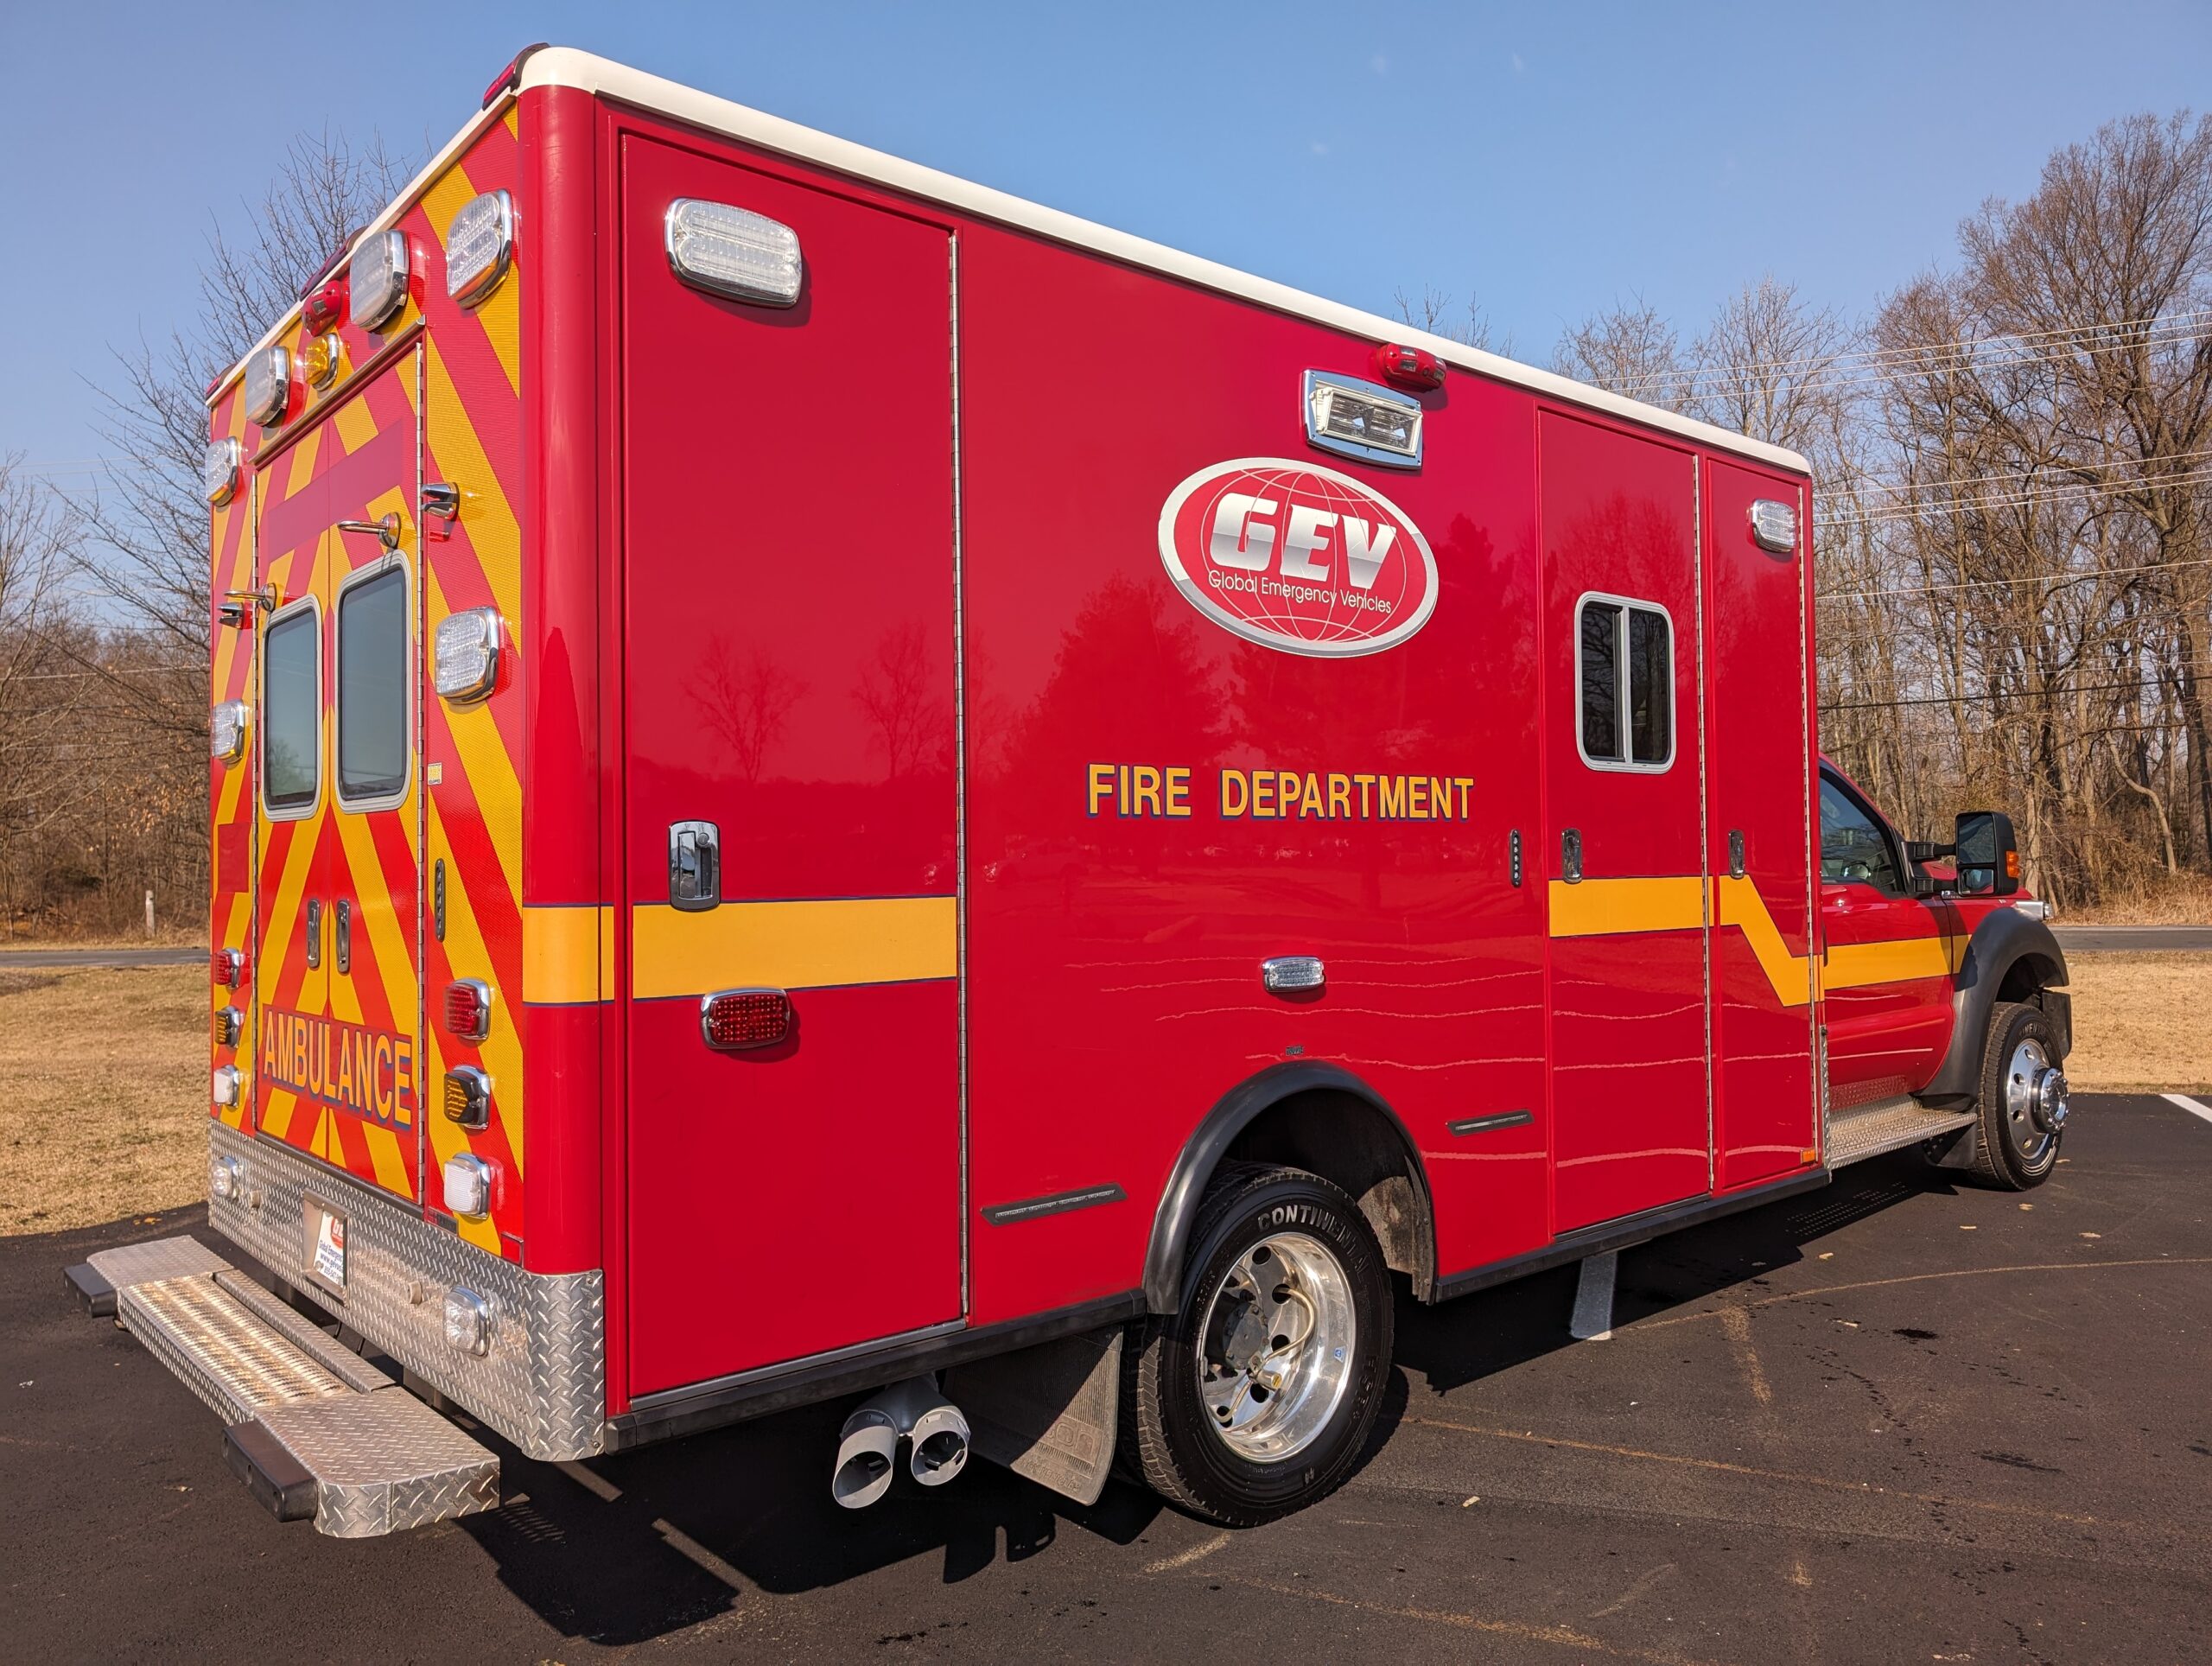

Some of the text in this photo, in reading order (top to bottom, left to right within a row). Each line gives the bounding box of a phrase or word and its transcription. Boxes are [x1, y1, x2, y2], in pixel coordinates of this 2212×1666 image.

[1210, 493, 1397, 589] GEV
[1209, 569, 1392, 614] Global Emergency Vehicles
[1088, 763, 1474, 820] FIRE DEPARTMENT
[264, 1010, 411, 1128] AMBULANCE
[1257, 1203, 1370, 1284] CONTINENTAL
